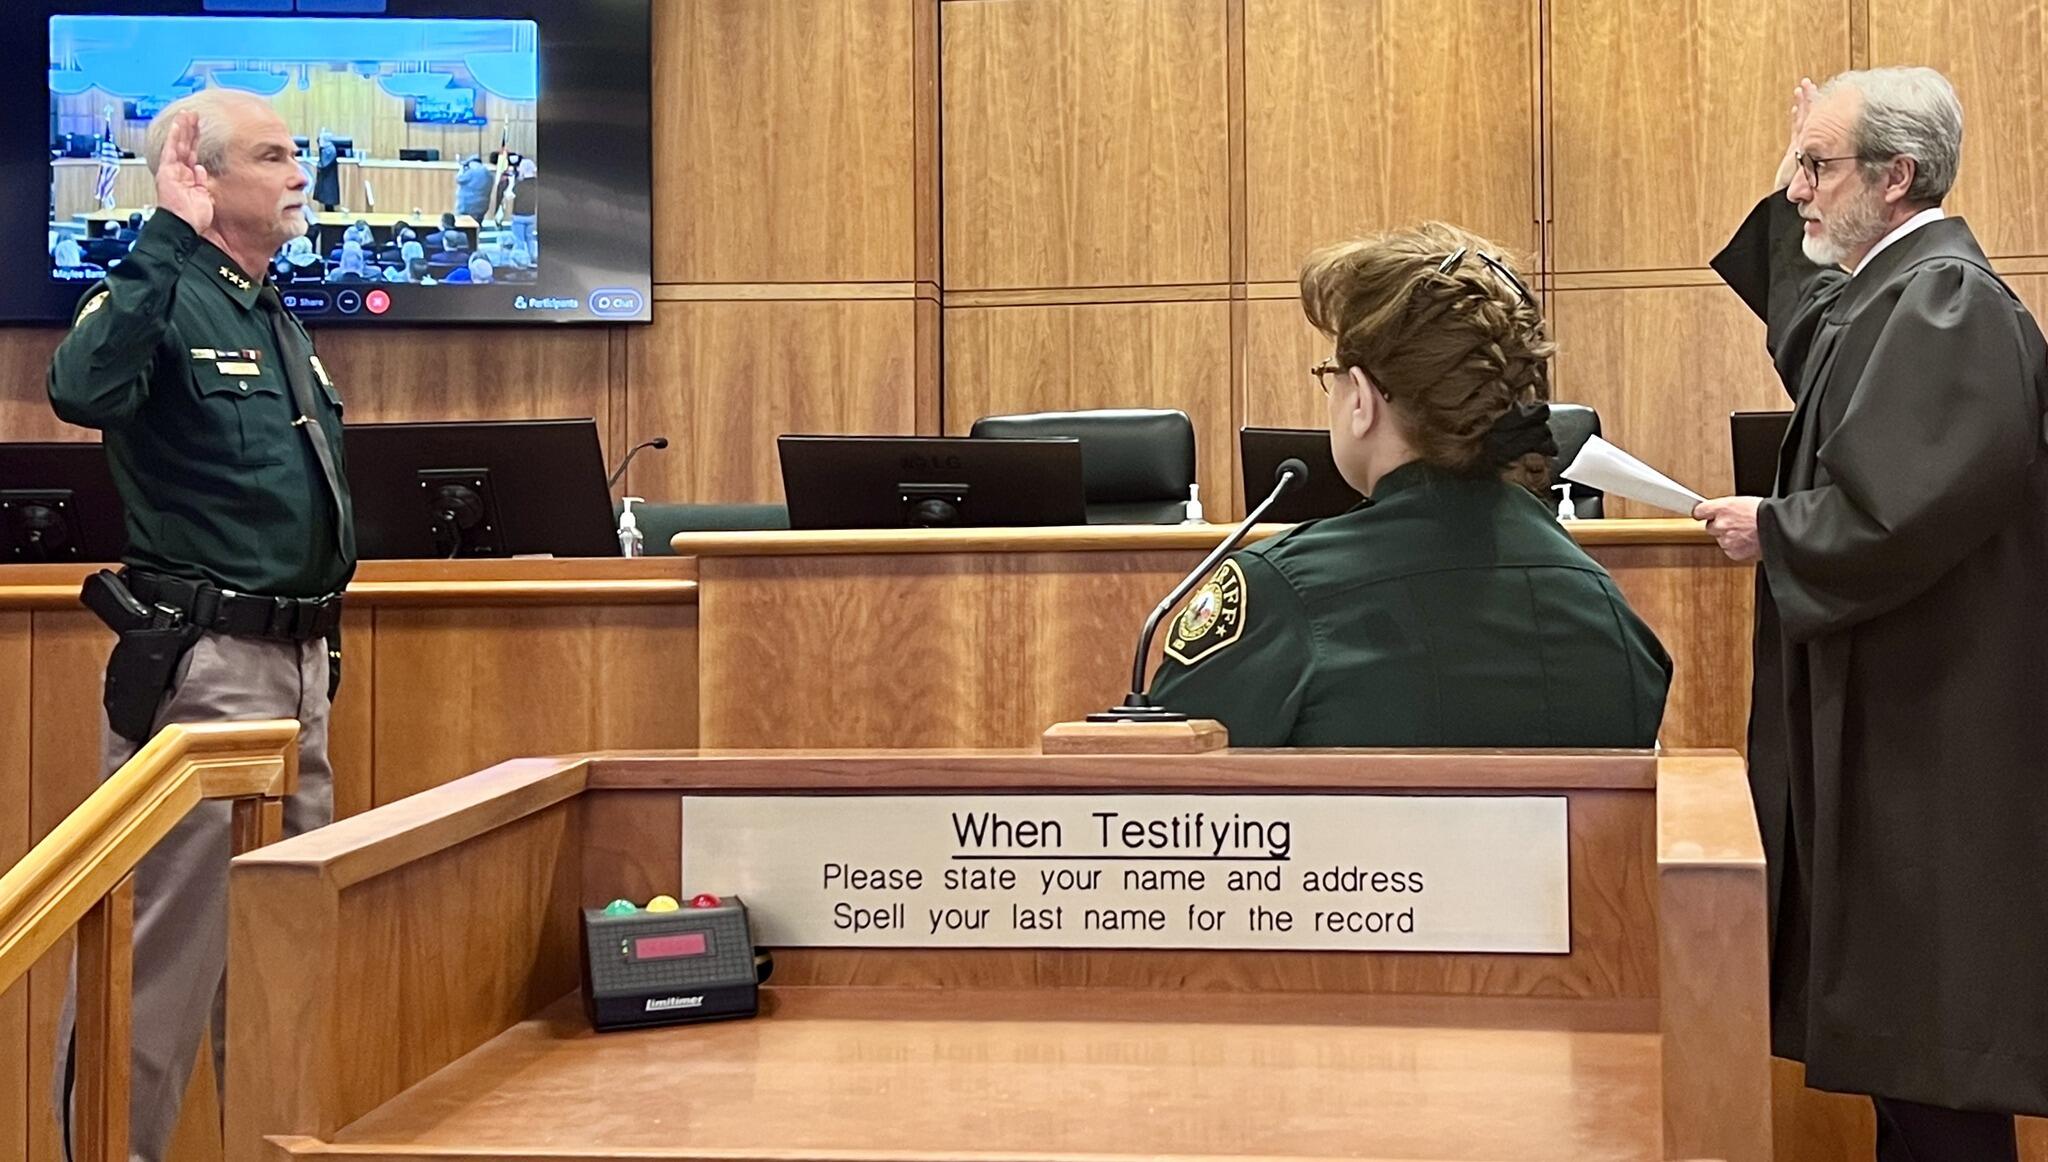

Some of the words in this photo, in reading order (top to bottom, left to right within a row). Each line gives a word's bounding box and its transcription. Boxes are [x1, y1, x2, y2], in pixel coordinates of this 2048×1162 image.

[299, 297, 325, 307] Share
[528, 297, 578, 309] Participants
[612, 297, 634, 308] Chat
[952, 812, 1062, 848] When
[1091, 812, 1290, 856] Testifying
[823, 863, 923, 890] Please
[944, 866, 1016, 890] state
[1040, 869, 1102, 894] your
[1124, 869, 1205, 891] name
[1227, 865, 1281, 892] and
[1302, 865, 1424, 893] address
[833, 902, 906, 934] Spell
[929, 908, 990, 935] your
[1013, 903, 1063, 931] last
[1084, 909, 1166, 931] name
[1188, 903, 1226, 931] for
[1249, 905, 1293, 932] the
[1315, 906, 1415, 934] record
[645, 996, 704, 1011] Limitimer
